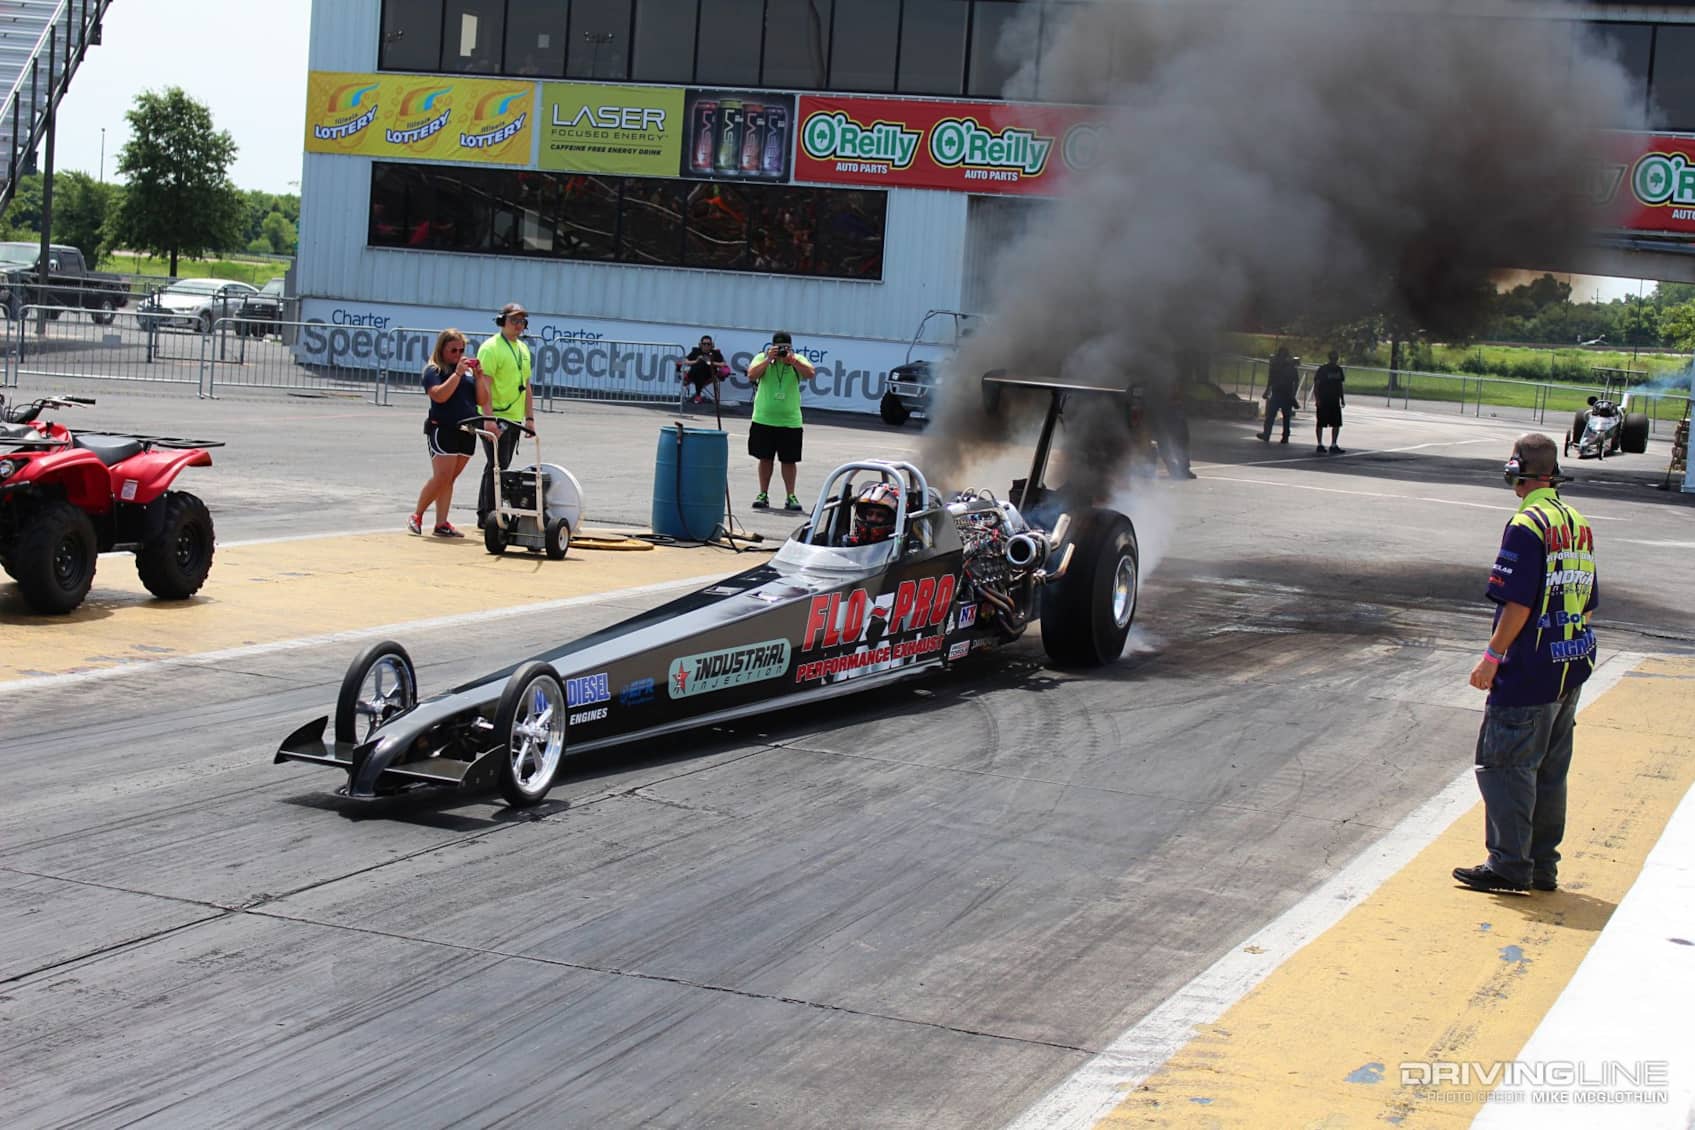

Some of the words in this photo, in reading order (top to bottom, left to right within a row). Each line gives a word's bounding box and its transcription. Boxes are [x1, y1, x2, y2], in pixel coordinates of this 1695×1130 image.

[315, 104, 378, 139] LOTTERY
[386, 108, 451, 144] LOTTERY
[460, 112, 527, 148] LOTTERY
[552, 103, 666, 132] LASER
[550, 144, 585, 152] CAFFEINE
[608, 146, 637, 155] ENERGY
[551, 129, 609, 139] FOCUSED
[614, 132, 666, 141] ENERGY
[805, 113, 921, 166] O'Reilly
[932, 118, 1050, 173] O'Reilly
[836, 162, 858, 173] AUTO
[859, 164, 888, 174] PARTS
[965, 169, 988, 179] AUTO
[989, 171, 1018, 181] PARTS
[332, 309, 391, 329] Charter
[541, 325, 603, 345] Charter
[796, 646, 890, 683] PERFORMANCE
[892, 634, 945, 661] EXHAUST
[567, 672, 611, 708] DIESEL
[569, 708, 608, 725] ENGINES
